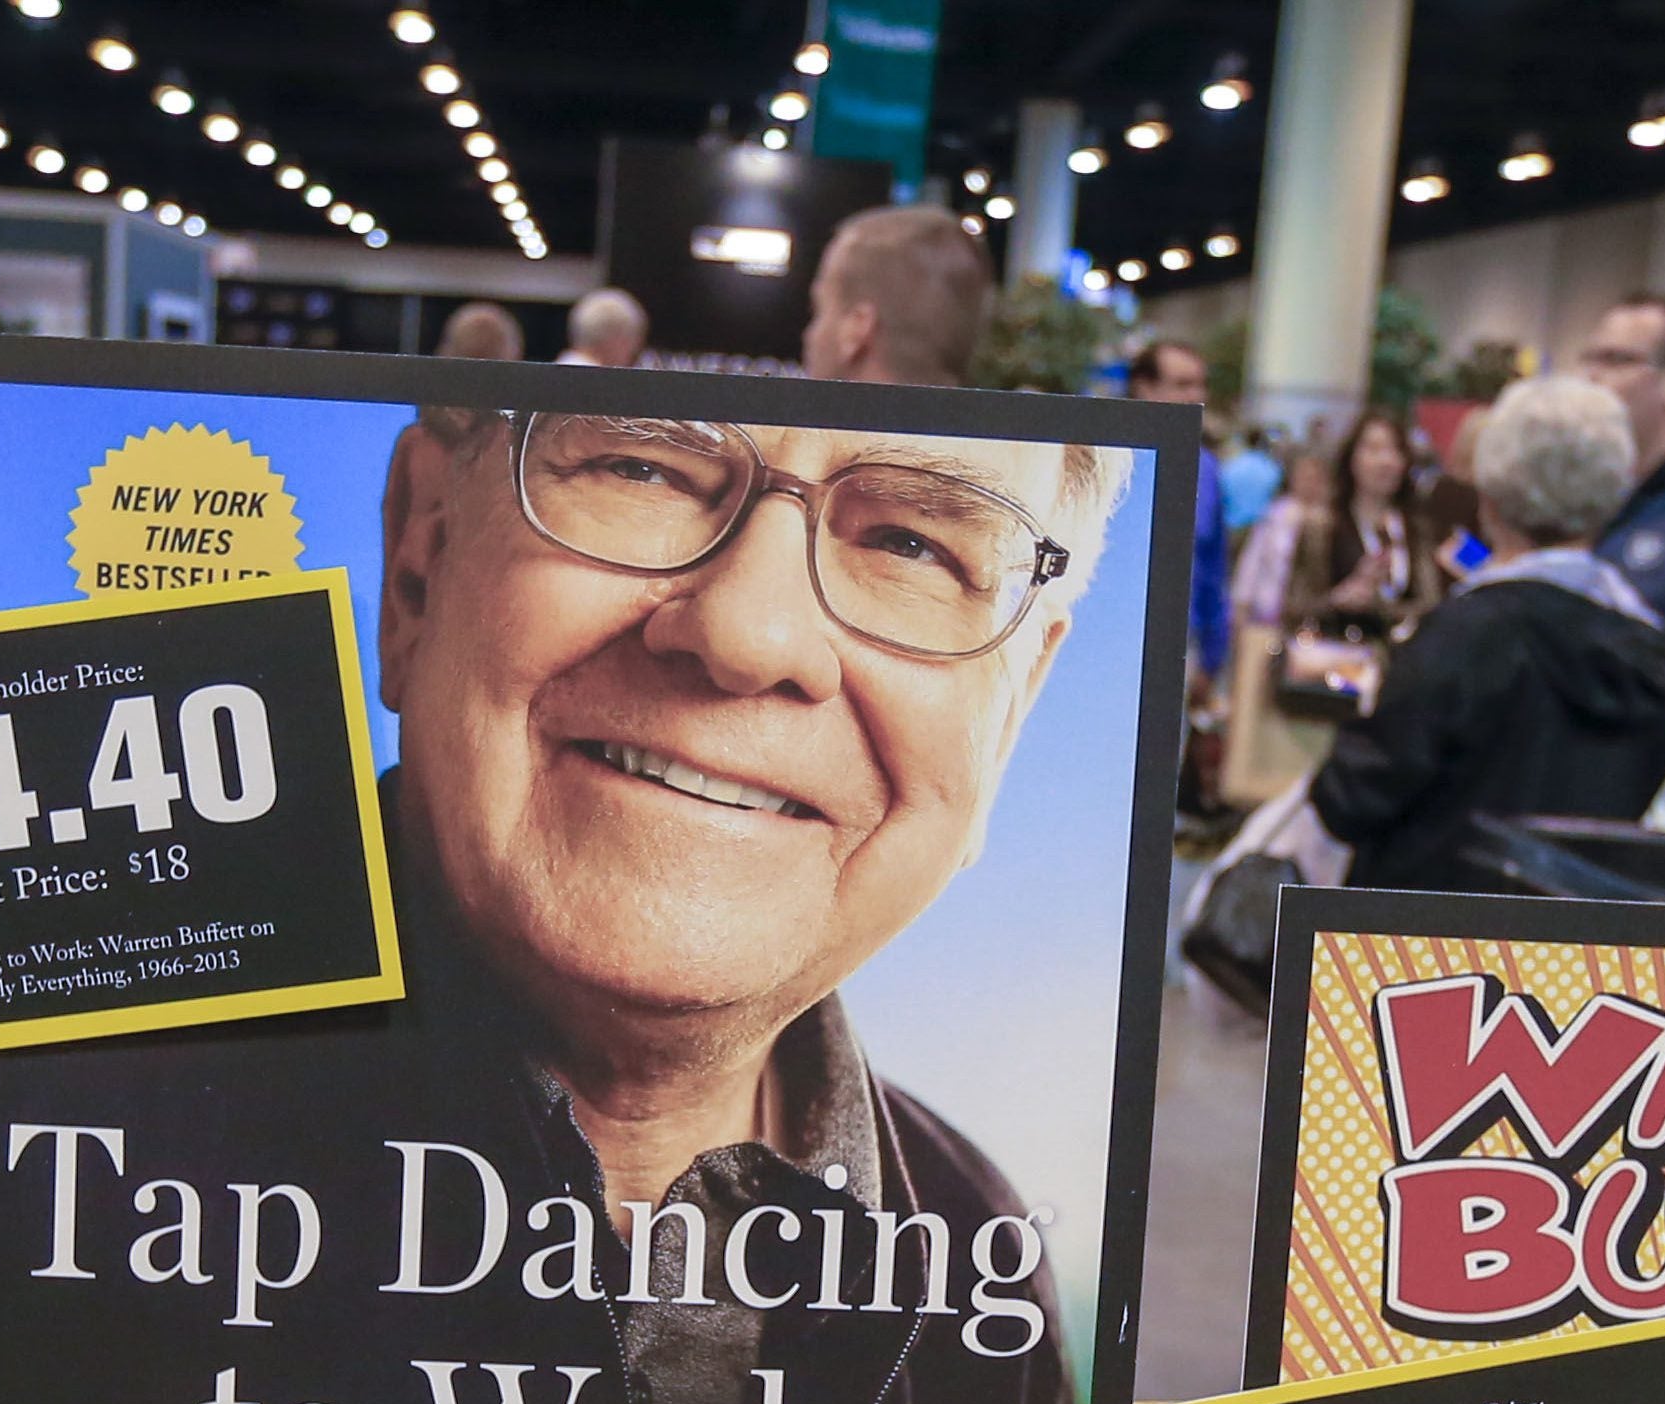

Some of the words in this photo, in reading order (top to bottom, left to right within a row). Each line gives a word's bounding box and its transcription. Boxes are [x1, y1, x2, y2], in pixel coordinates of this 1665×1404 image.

[112, 485, 181, 513] NEW
[193, 489, 268, 518] YORK
[145, 526, 233, 555] TIMES
[75, 663, 145, 689] Price:
[13, 865, 109, 900] Price:
[129, 844, 190, 885] $18
[7, 951, 27, 968] to
[31, 942, 94, 964] Work:
[99, 932, 173, 955] Warren
[178, 922, 245, 946] Buffett
[250, 921, 275, 937] on
[22, 966, 133, 994] Everything,
[137, 950, 241, 981] 1966-2013
[7, 1124, 322, 1328] Tap
[379, 1141, 1054, 1358] Dancing
